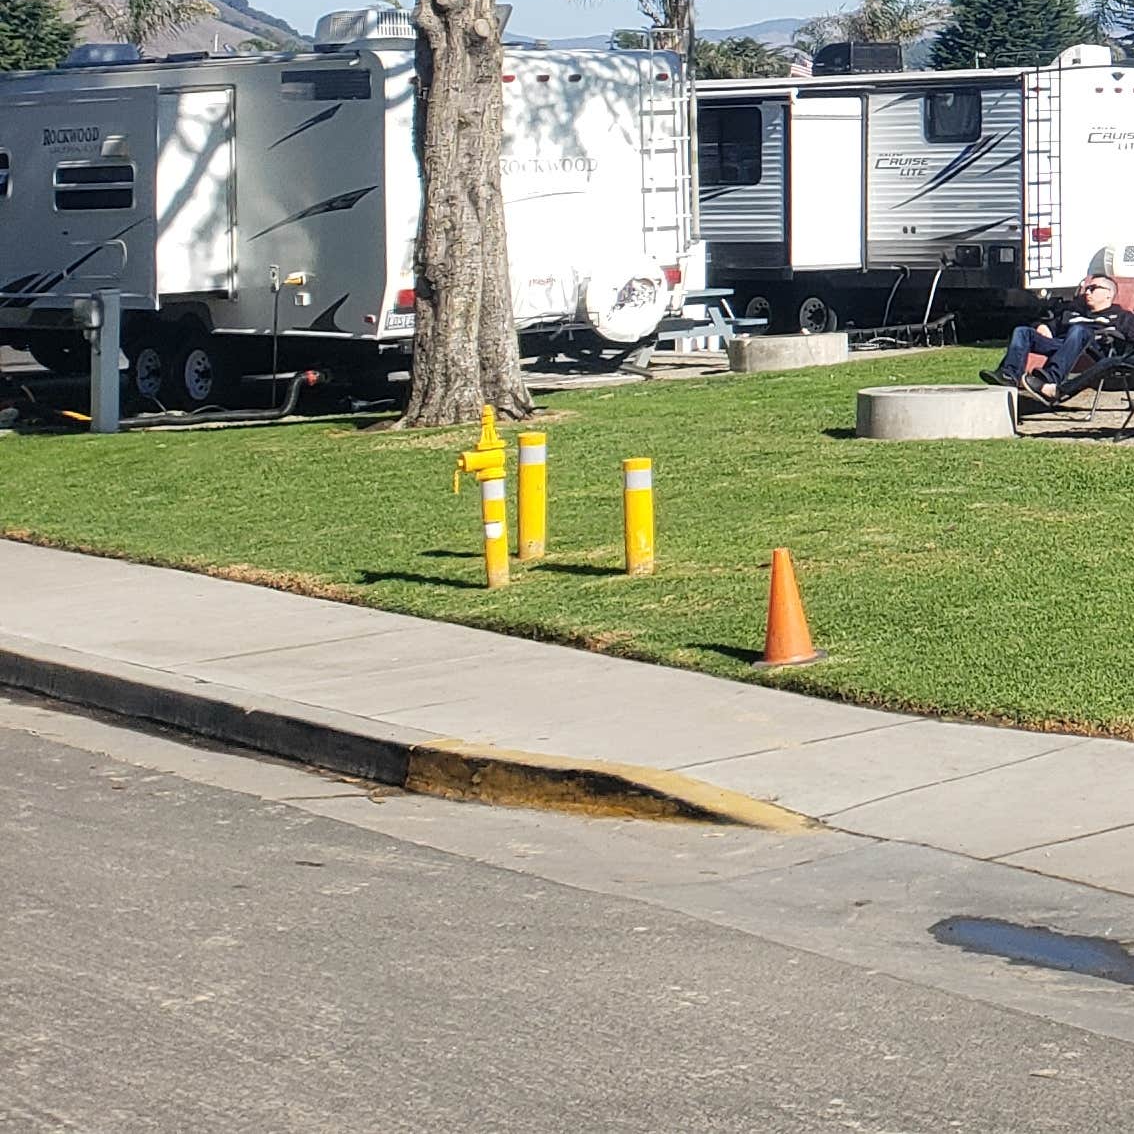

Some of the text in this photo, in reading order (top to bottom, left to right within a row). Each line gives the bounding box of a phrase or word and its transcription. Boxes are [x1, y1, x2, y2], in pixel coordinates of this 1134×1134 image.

[42, 127, 100, 146] ROCKWOOD
[875, 158, 928, 169] CRUISE
[900, 168, 928, 176] LITE
